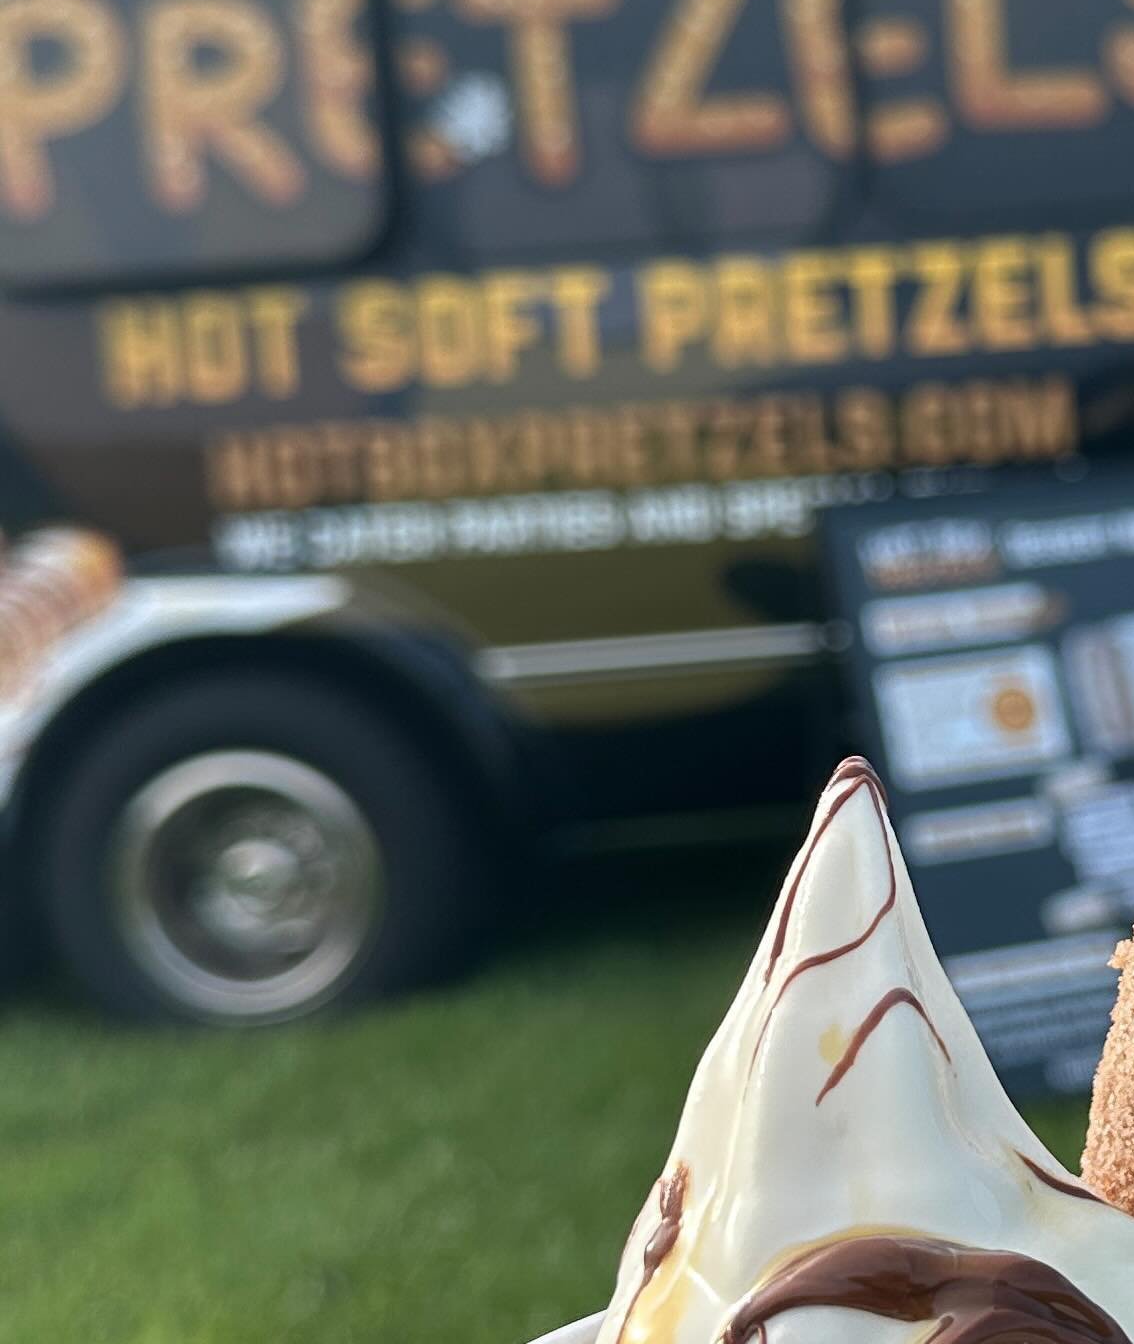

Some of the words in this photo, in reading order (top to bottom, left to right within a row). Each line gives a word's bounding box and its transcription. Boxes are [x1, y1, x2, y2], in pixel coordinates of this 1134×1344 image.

[104, 288, 306, 407] HOT
[339, 268, 605, 388] SOFT
[212, 380, 1070, 506] HOTBOXPRETZELS.COM
